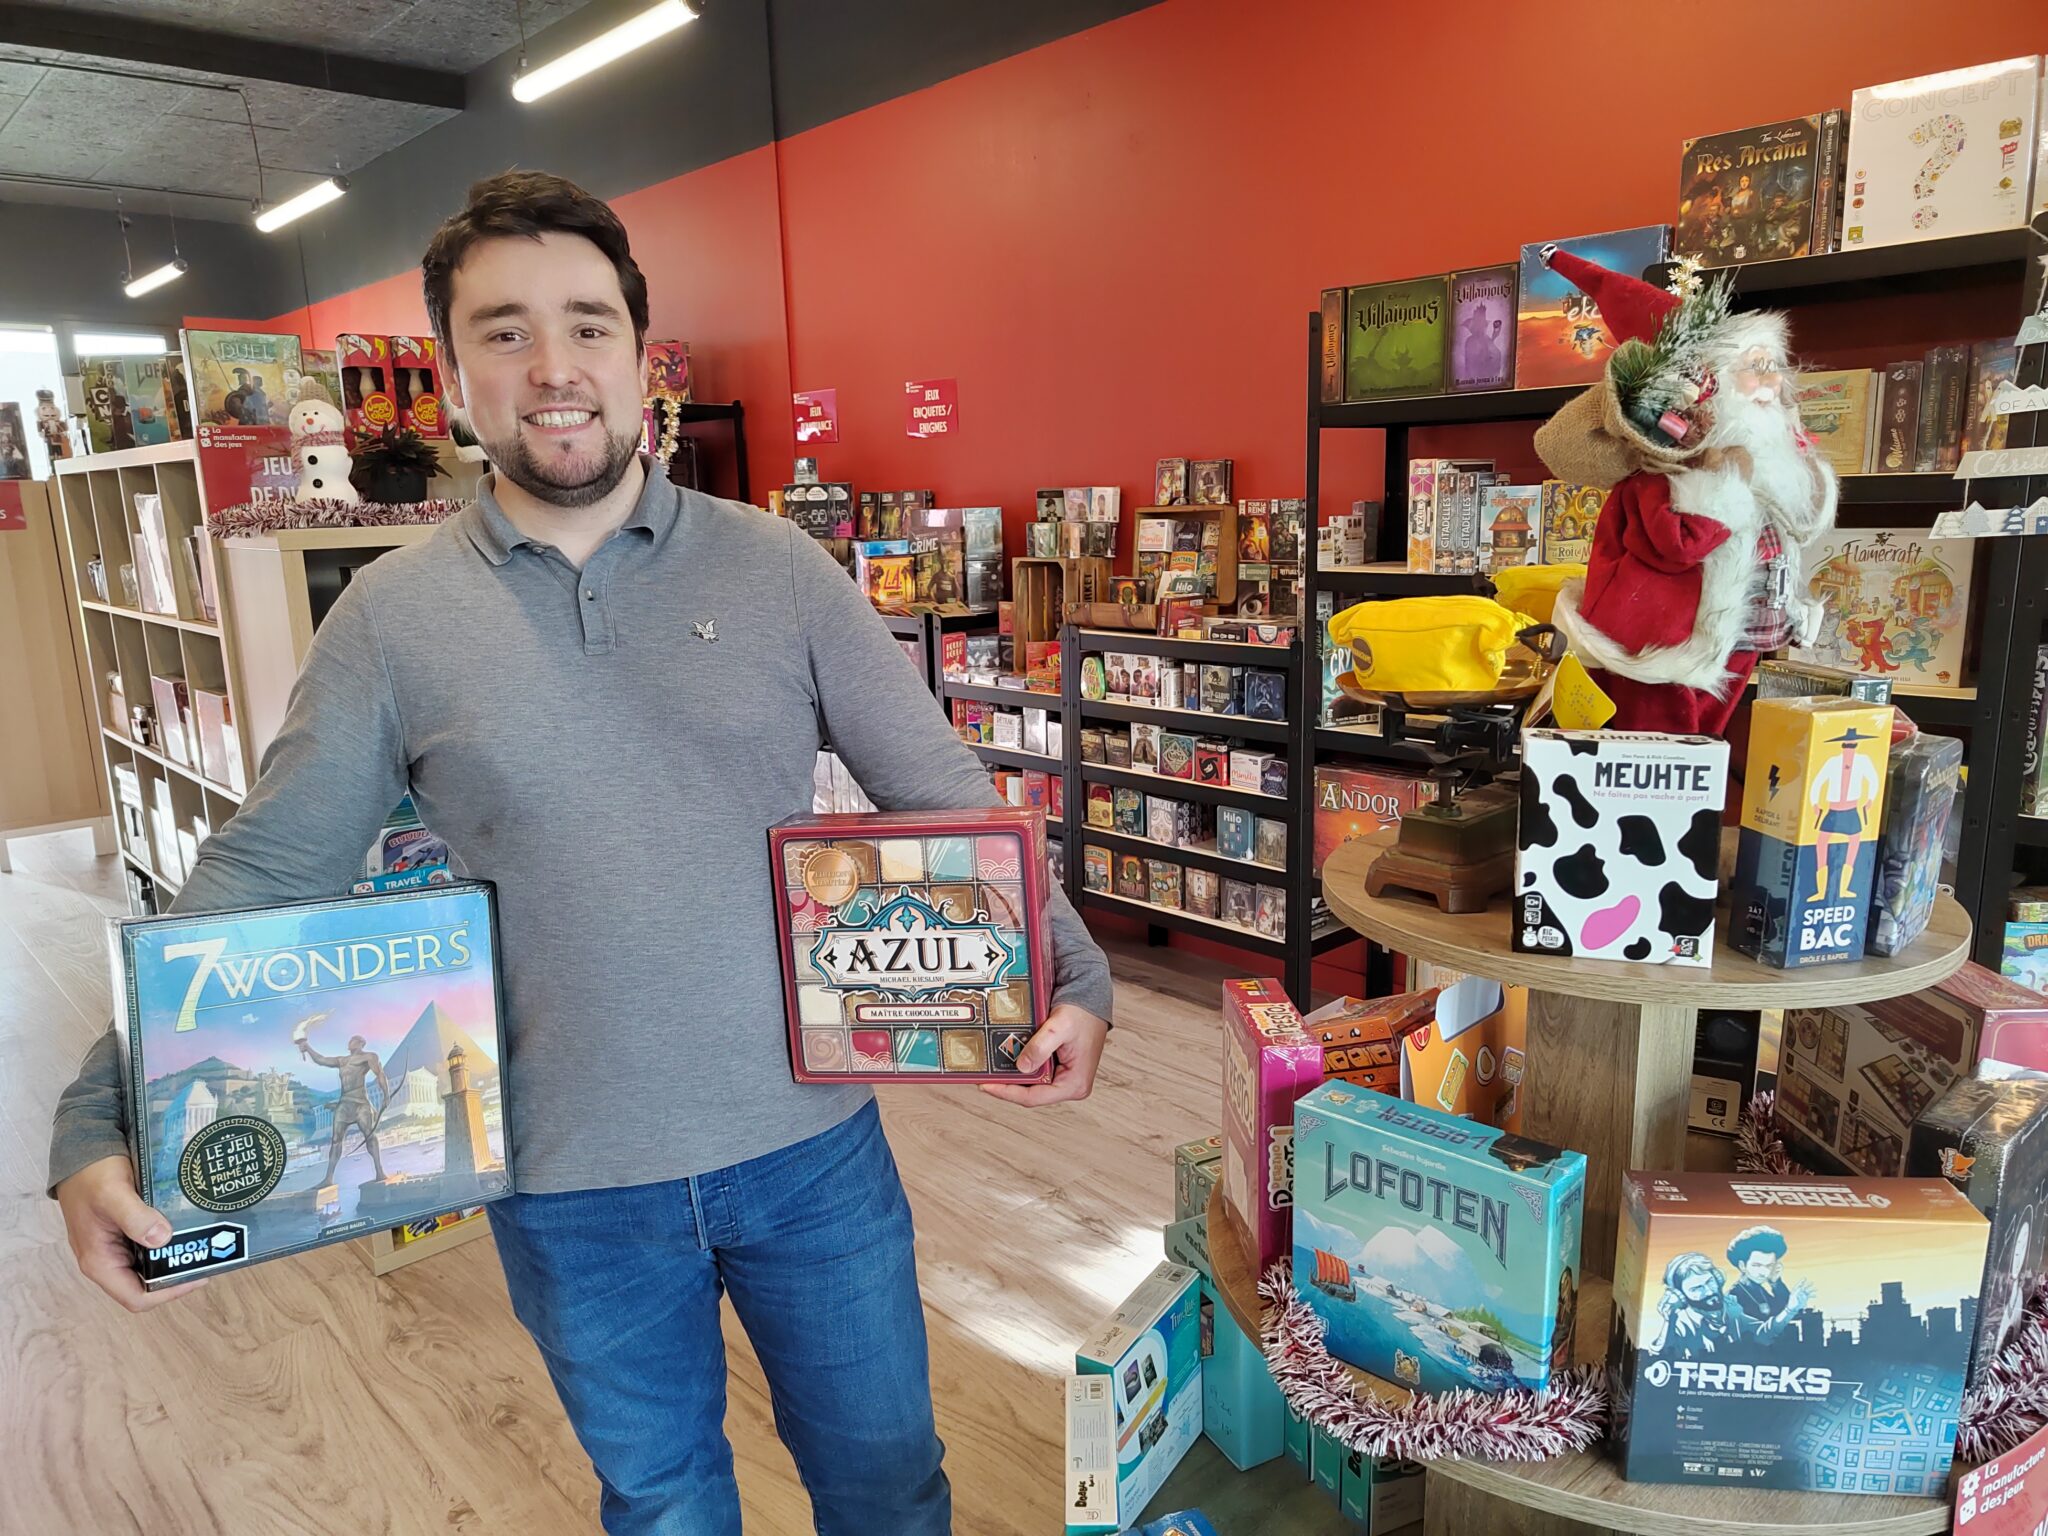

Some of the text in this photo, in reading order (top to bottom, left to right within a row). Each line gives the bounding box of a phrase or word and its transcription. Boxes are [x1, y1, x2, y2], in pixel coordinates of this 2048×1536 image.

[1861, 70, 2024, 123] CONCEPT
[1696, 139, 1809, 176] Res Arcana
[1455, 280, 1513, 304] Villainous
[1354, 296, 1441, 333] Villainous
[925, 389, 940, 401] JEUX
[809, 406, 823, 418] JEUX
[919, 421, 948, 434] ENIGMES
[263, 457, 293, 476] JEU
[1441, 497, 1451, 548] CITADELLES
[1461, 497, 1471, 548] CITADELLES
[909, 537, 939, 554] CRIME
[1558, 546, 1574, 558] Roi
[1841, 539, 1924, 565] Flamecraft
[1175, 580, 1193, 593] Hilo
[1594, 761, 1712, 792] MEUHTE
[1320, 783, 1402, 822] ANDOR
[1608, 789, 1631, 798] faites
[1633, 791, 1648, 800] pas
[1650, 791, 1676, 801] vache
[1685, 792, 1703, 802] part
[1223, 811, 1242, 823] Hilo
[384, 876, 423, 891] TRAVEL
[1802, 905, 1856, 926] SPEED
[1800, 923, 1853, 951] BAC
[846, 937, 976, 974] AZUL
[162, 928, 471, 1033] 7 WONDERS
[879, 975, 945, 984] MICHAEL KIESLING
[870, 1007, 960, 1017] MAÎTRE CHOCOLATIER
[1376, 1105, 1493, 1150] LOFOTEN
[205, 1134, 254, 1161] LE JEU
[208, 1148, 257, 1174] LE PLUS
[210, 1161, 260, 1185] PRIMÉ AU
[213, 1171, 262, 1197] MONDE
[1323, 1140, 1512, 1271] LOFOTEN
[1736, 1190, 1872, 1208] TRACKS
[148, 1236, 209, 1261] UNBOX
[167, 1249, 209, 1268] NOW
[1673, 1361, 1833, 1396] TRACKS
[1981, 1446, 2046, 1498] manufacture
[1984, 1462, 2000, 1480] La
[1980, 1479, 2025, 1514] des jeux
